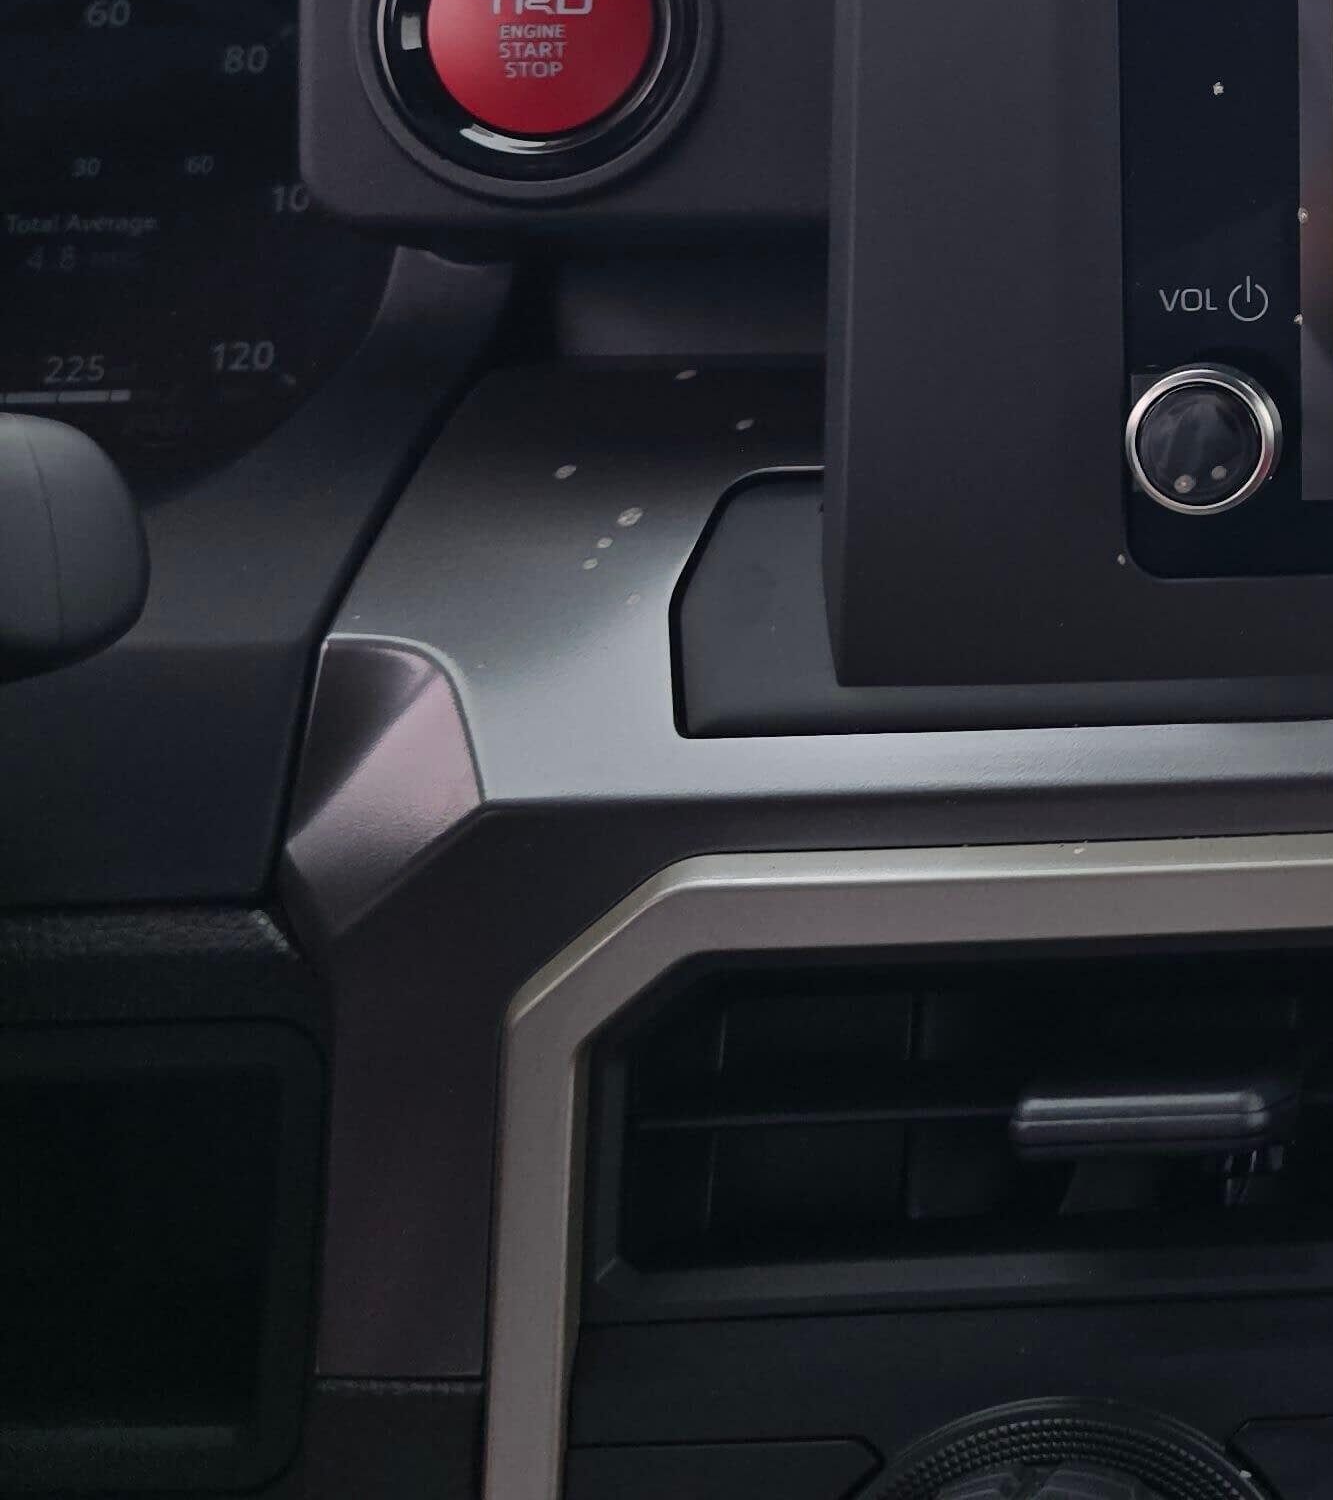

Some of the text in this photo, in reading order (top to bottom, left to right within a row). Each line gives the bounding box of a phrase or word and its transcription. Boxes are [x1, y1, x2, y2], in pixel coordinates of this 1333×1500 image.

[85, 0, 131, 27] 60
[500, 24, 566, 39] ENGINE
[222, 45, 269, 73] 80
[499, 41, 568, 59] START
[505, 61, 563, 78] STOP
[1159, 288, 1218, 312] VOL
[212, 340, 275, 372] 120
[44, 354, 105, 384] 225
